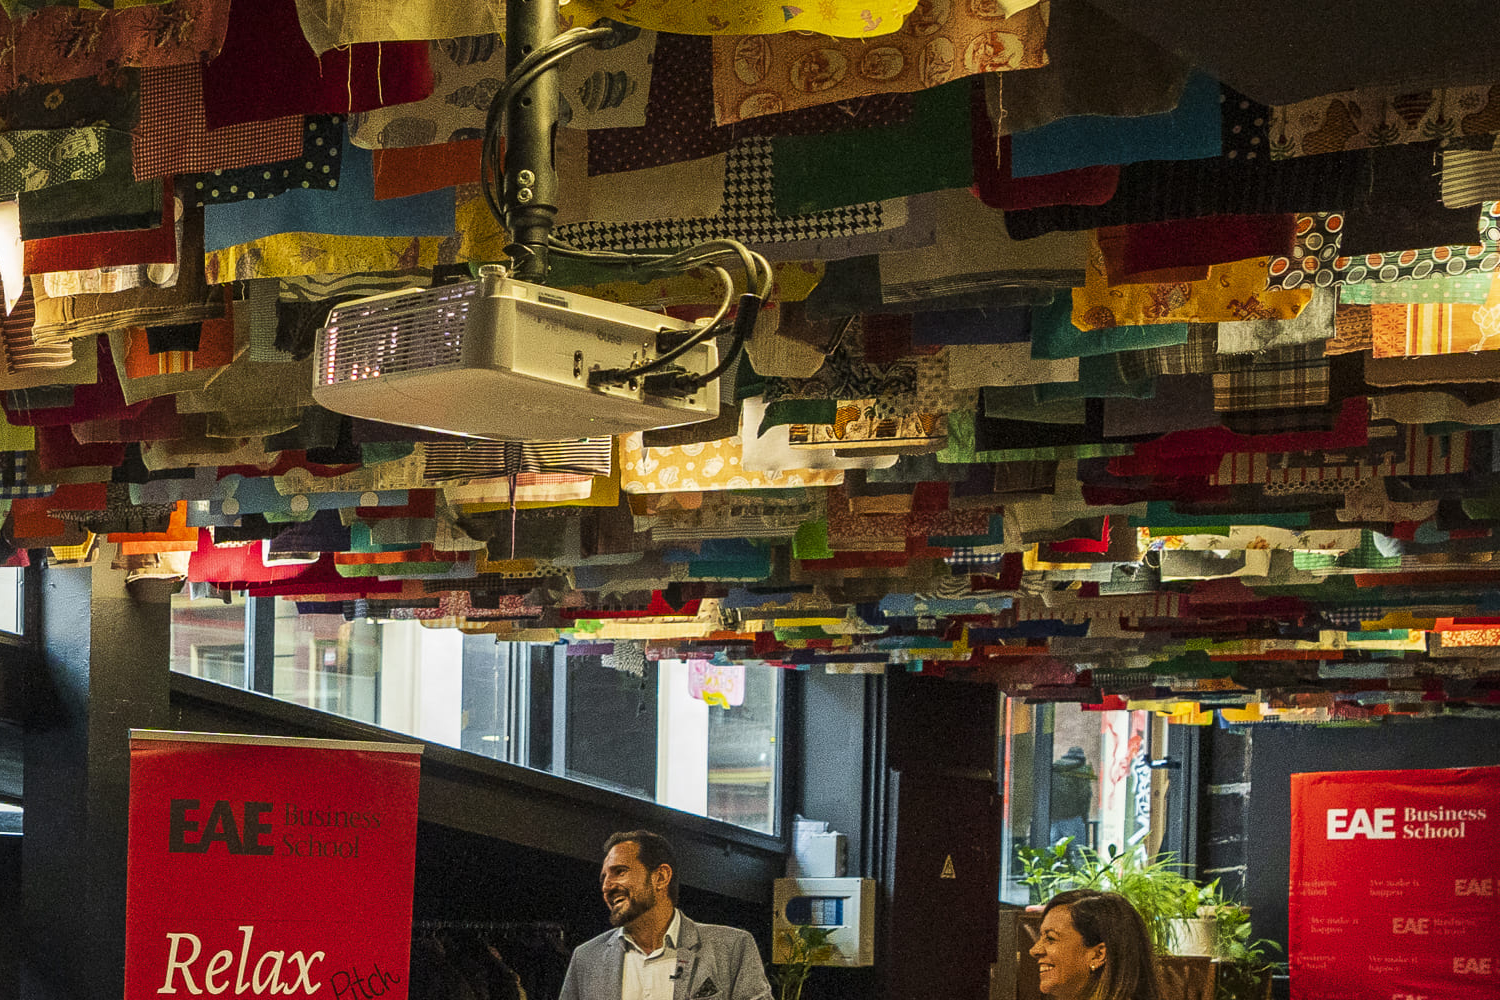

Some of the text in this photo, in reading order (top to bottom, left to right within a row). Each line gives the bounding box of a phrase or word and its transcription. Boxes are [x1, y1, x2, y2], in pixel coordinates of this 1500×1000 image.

[283, 802, 381, 829] Business
[1326, 807, 1396, 840] EAE
[1404, 805, 1487, 823] Business
[168, 798, 274, 856] EAE
[1402, 821, 1466, 840] School
[281, 833, 359, 858] School
[1455, 879, 1493, 896] EAE
[1392, 917, 1429, 935] EAE
[156, 925, 326, 995] Relax
[1453, 957, 1492, 974] EAE
